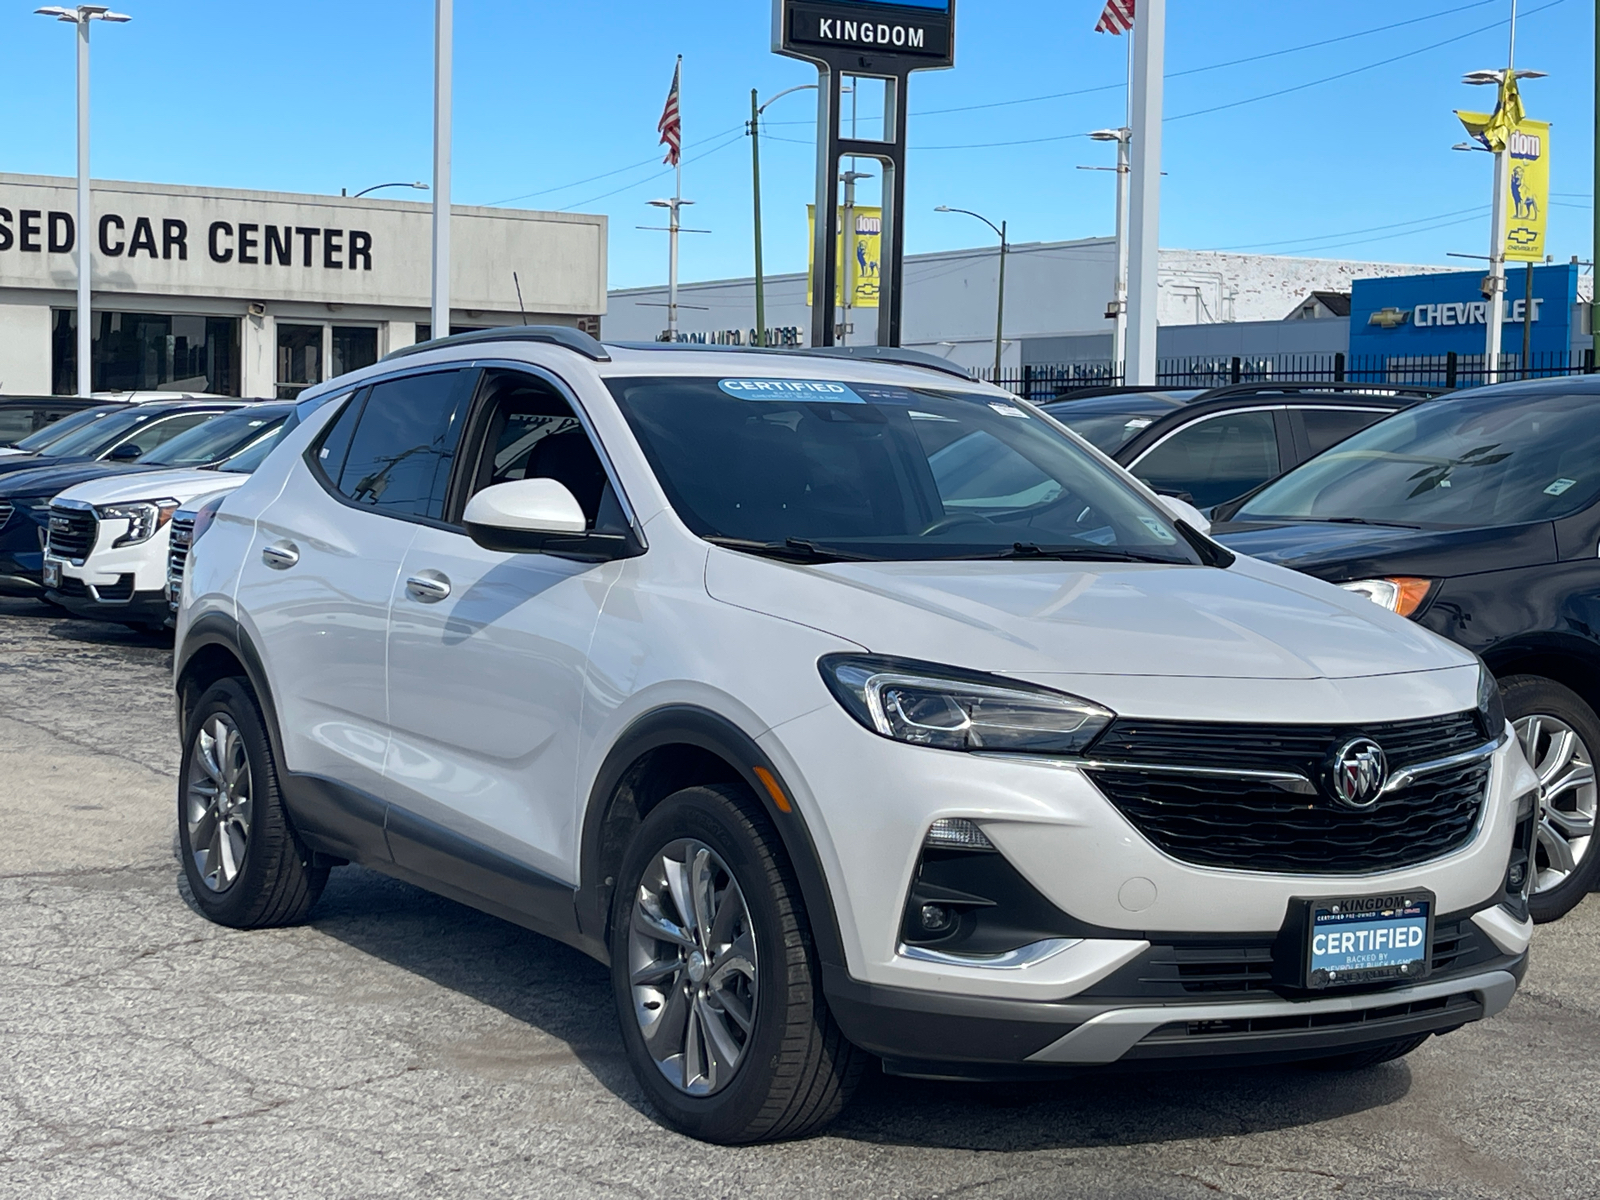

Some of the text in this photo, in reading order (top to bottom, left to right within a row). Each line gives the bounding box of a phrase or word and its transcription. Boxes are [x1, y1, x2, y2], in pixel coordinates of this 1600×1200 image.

[819, 18, 924, 48] KINGDOM
[1510, 130, 1540, 157] dom
[856, 215, 881, 234] dom
[99, 213, 188, 261] CAR
[208, 220, 373, 272] CENTER
[1413, 298, 1544, 327] CHEVRLET
[749, 326, 802, 347] CNTER
[724, 381, 845, 393] CERTIFIED
[1340, 896, 1406, 912] KINGDOM
[1317, 913, 1345, 922] CERTIFIED
[1312, 926, 1423, 956] CERTIFIED
[1346, 953, 1388, 964] BACKED BY
